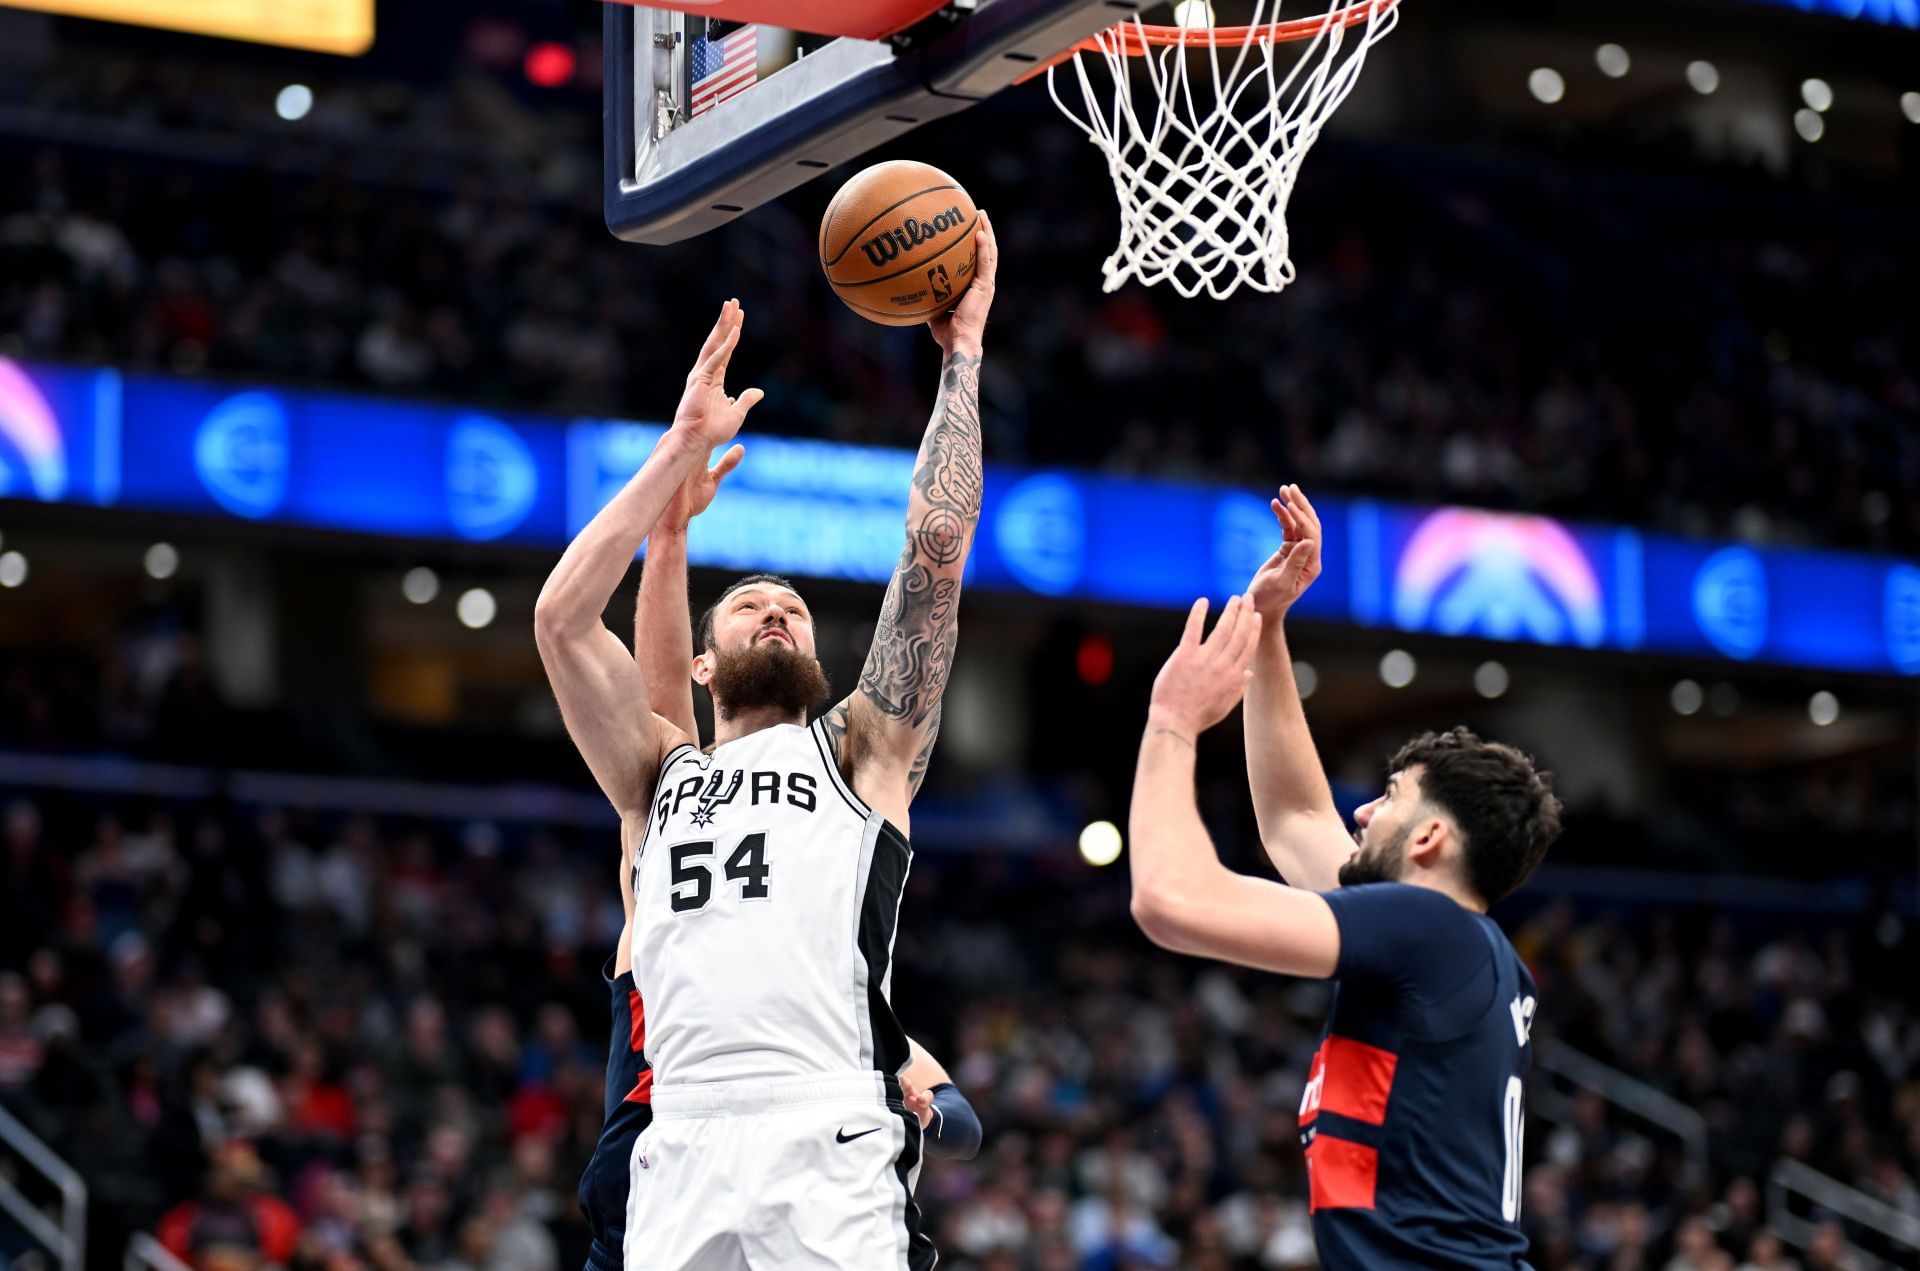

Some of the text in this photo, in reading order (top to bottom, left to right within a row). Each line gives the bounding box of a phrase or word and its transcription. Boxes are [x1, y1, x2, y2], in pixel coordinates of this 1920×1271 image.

[861, 206, 965, 267] Wilson
[657, 769, 817, 836] SPURS
[669, 829, 772, 917] 54
